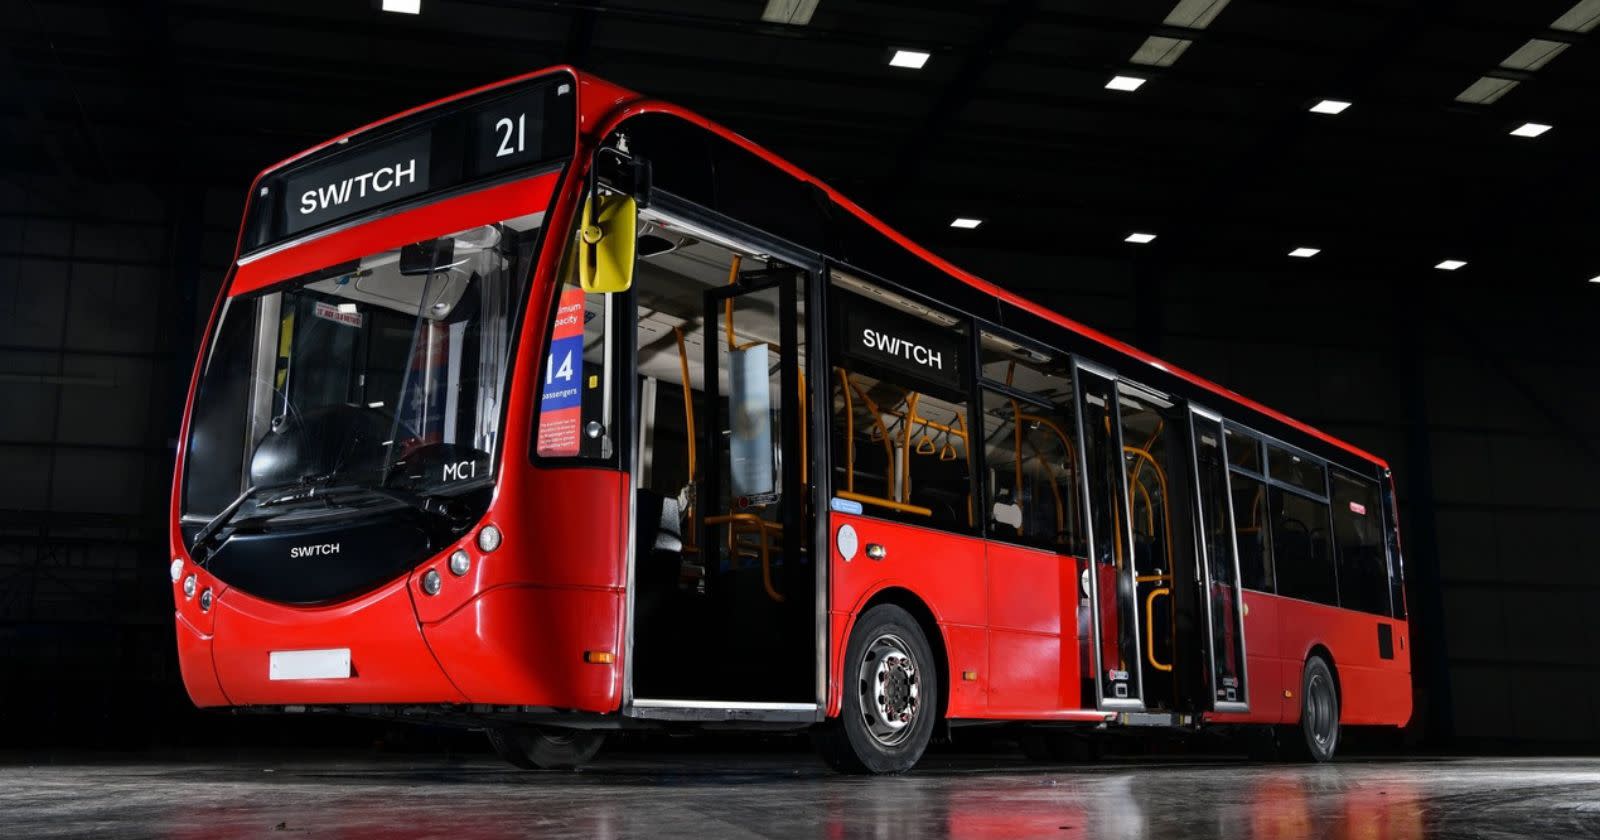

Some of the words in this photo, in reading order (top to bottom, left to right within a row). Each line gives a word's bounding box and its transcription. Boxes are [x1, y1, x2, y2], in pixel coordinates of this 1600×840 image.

[495, 113, 526, 157] 21
[300, 159, 416, 214] SWITCH
[546, 349, 573, 385] 14
[862, 328, 942, 369] SWITCH
[442, 460, 476, 482] MC1
[290, 543, 340, 559] SWITCH
